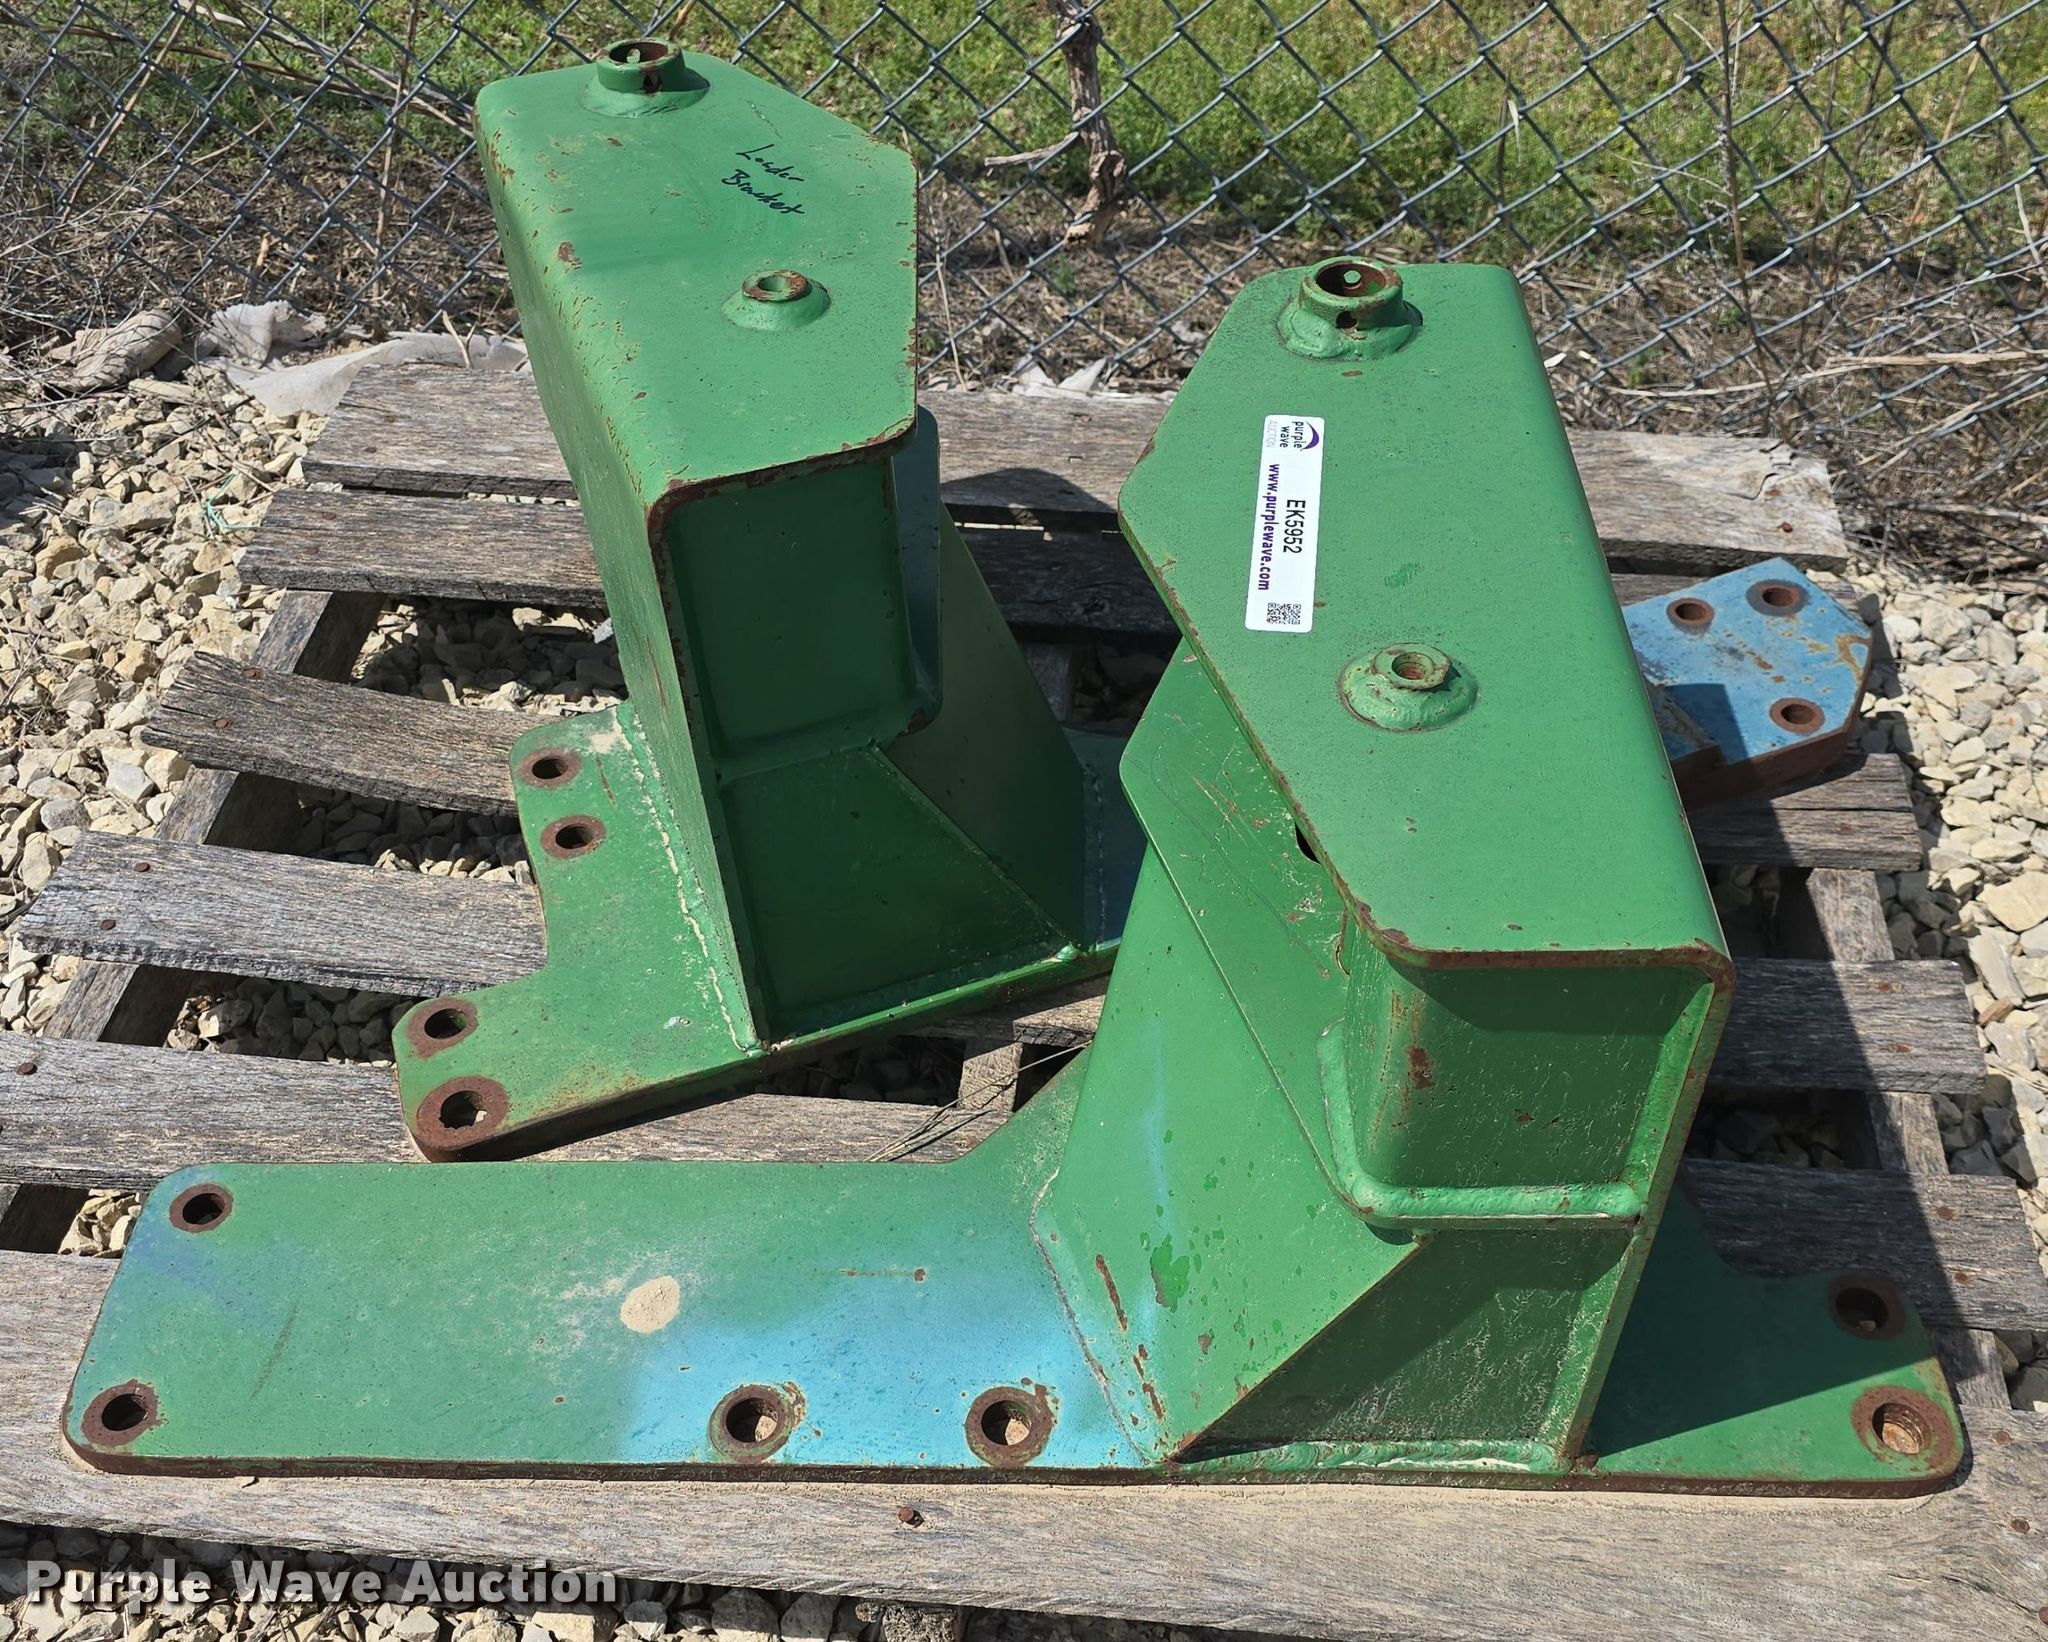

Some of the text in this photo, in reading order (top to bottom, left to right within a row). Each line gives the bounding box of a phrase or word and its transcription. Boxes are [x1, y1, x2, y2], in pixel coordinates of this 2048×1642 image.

[1267, 420, 1278, 448] AUCTION
[1280, 426, 1290, 448] wave
[1291, 421, 1306, 448] purple
[1258, 463, 1280, 591] www.purplewave.com
[1283, 499, 1306, 554] EK5952
